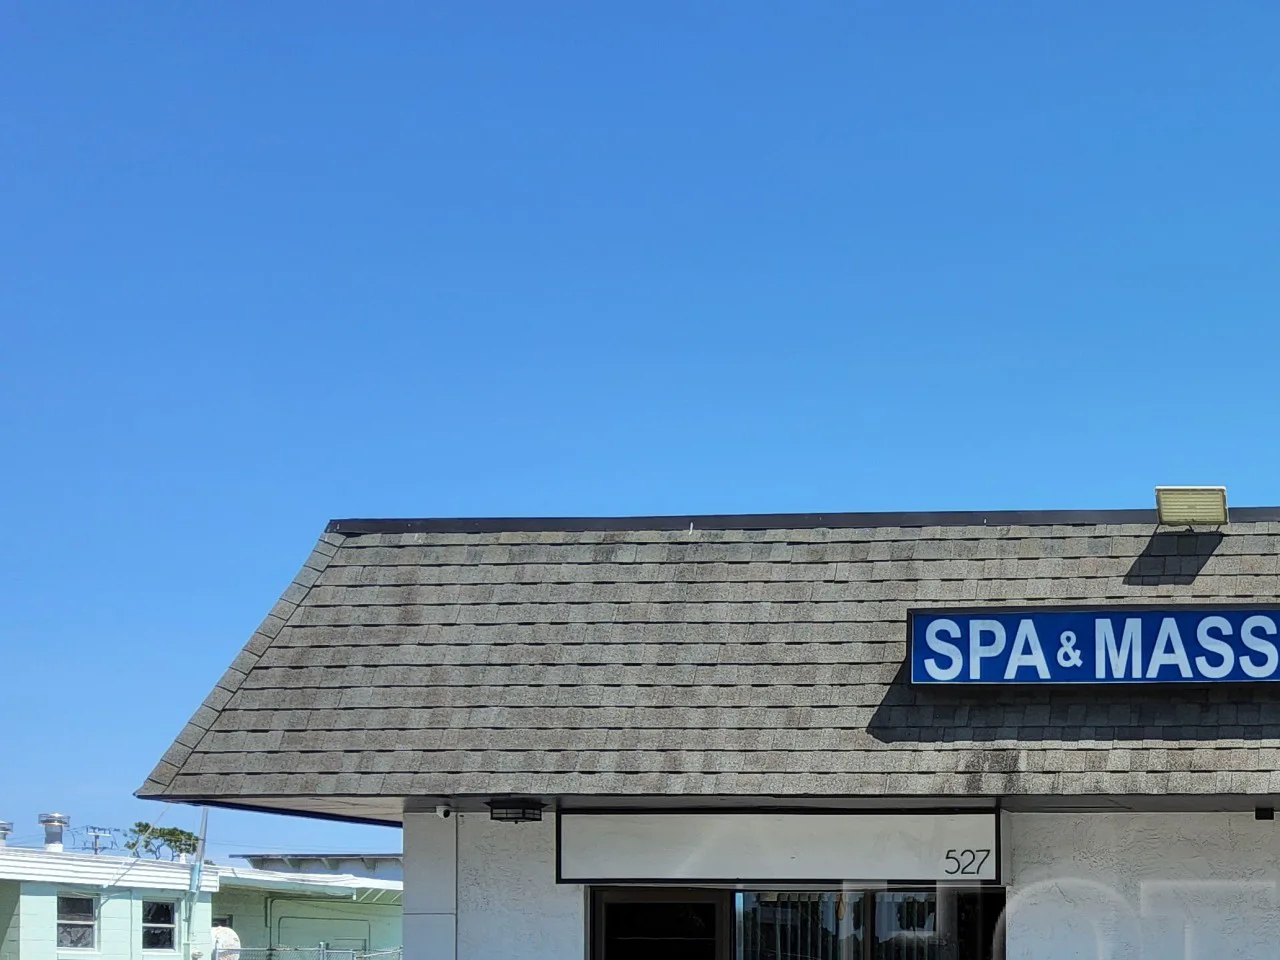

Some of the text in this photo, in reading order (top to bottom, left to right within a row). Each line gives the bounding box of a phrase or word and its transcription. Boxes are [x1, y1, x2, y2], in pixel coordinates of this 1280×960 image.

[924, 619, 1050, 681] SPA
[1057, 630, 1083, 668] &
[944, 849, 991, 875] 527
